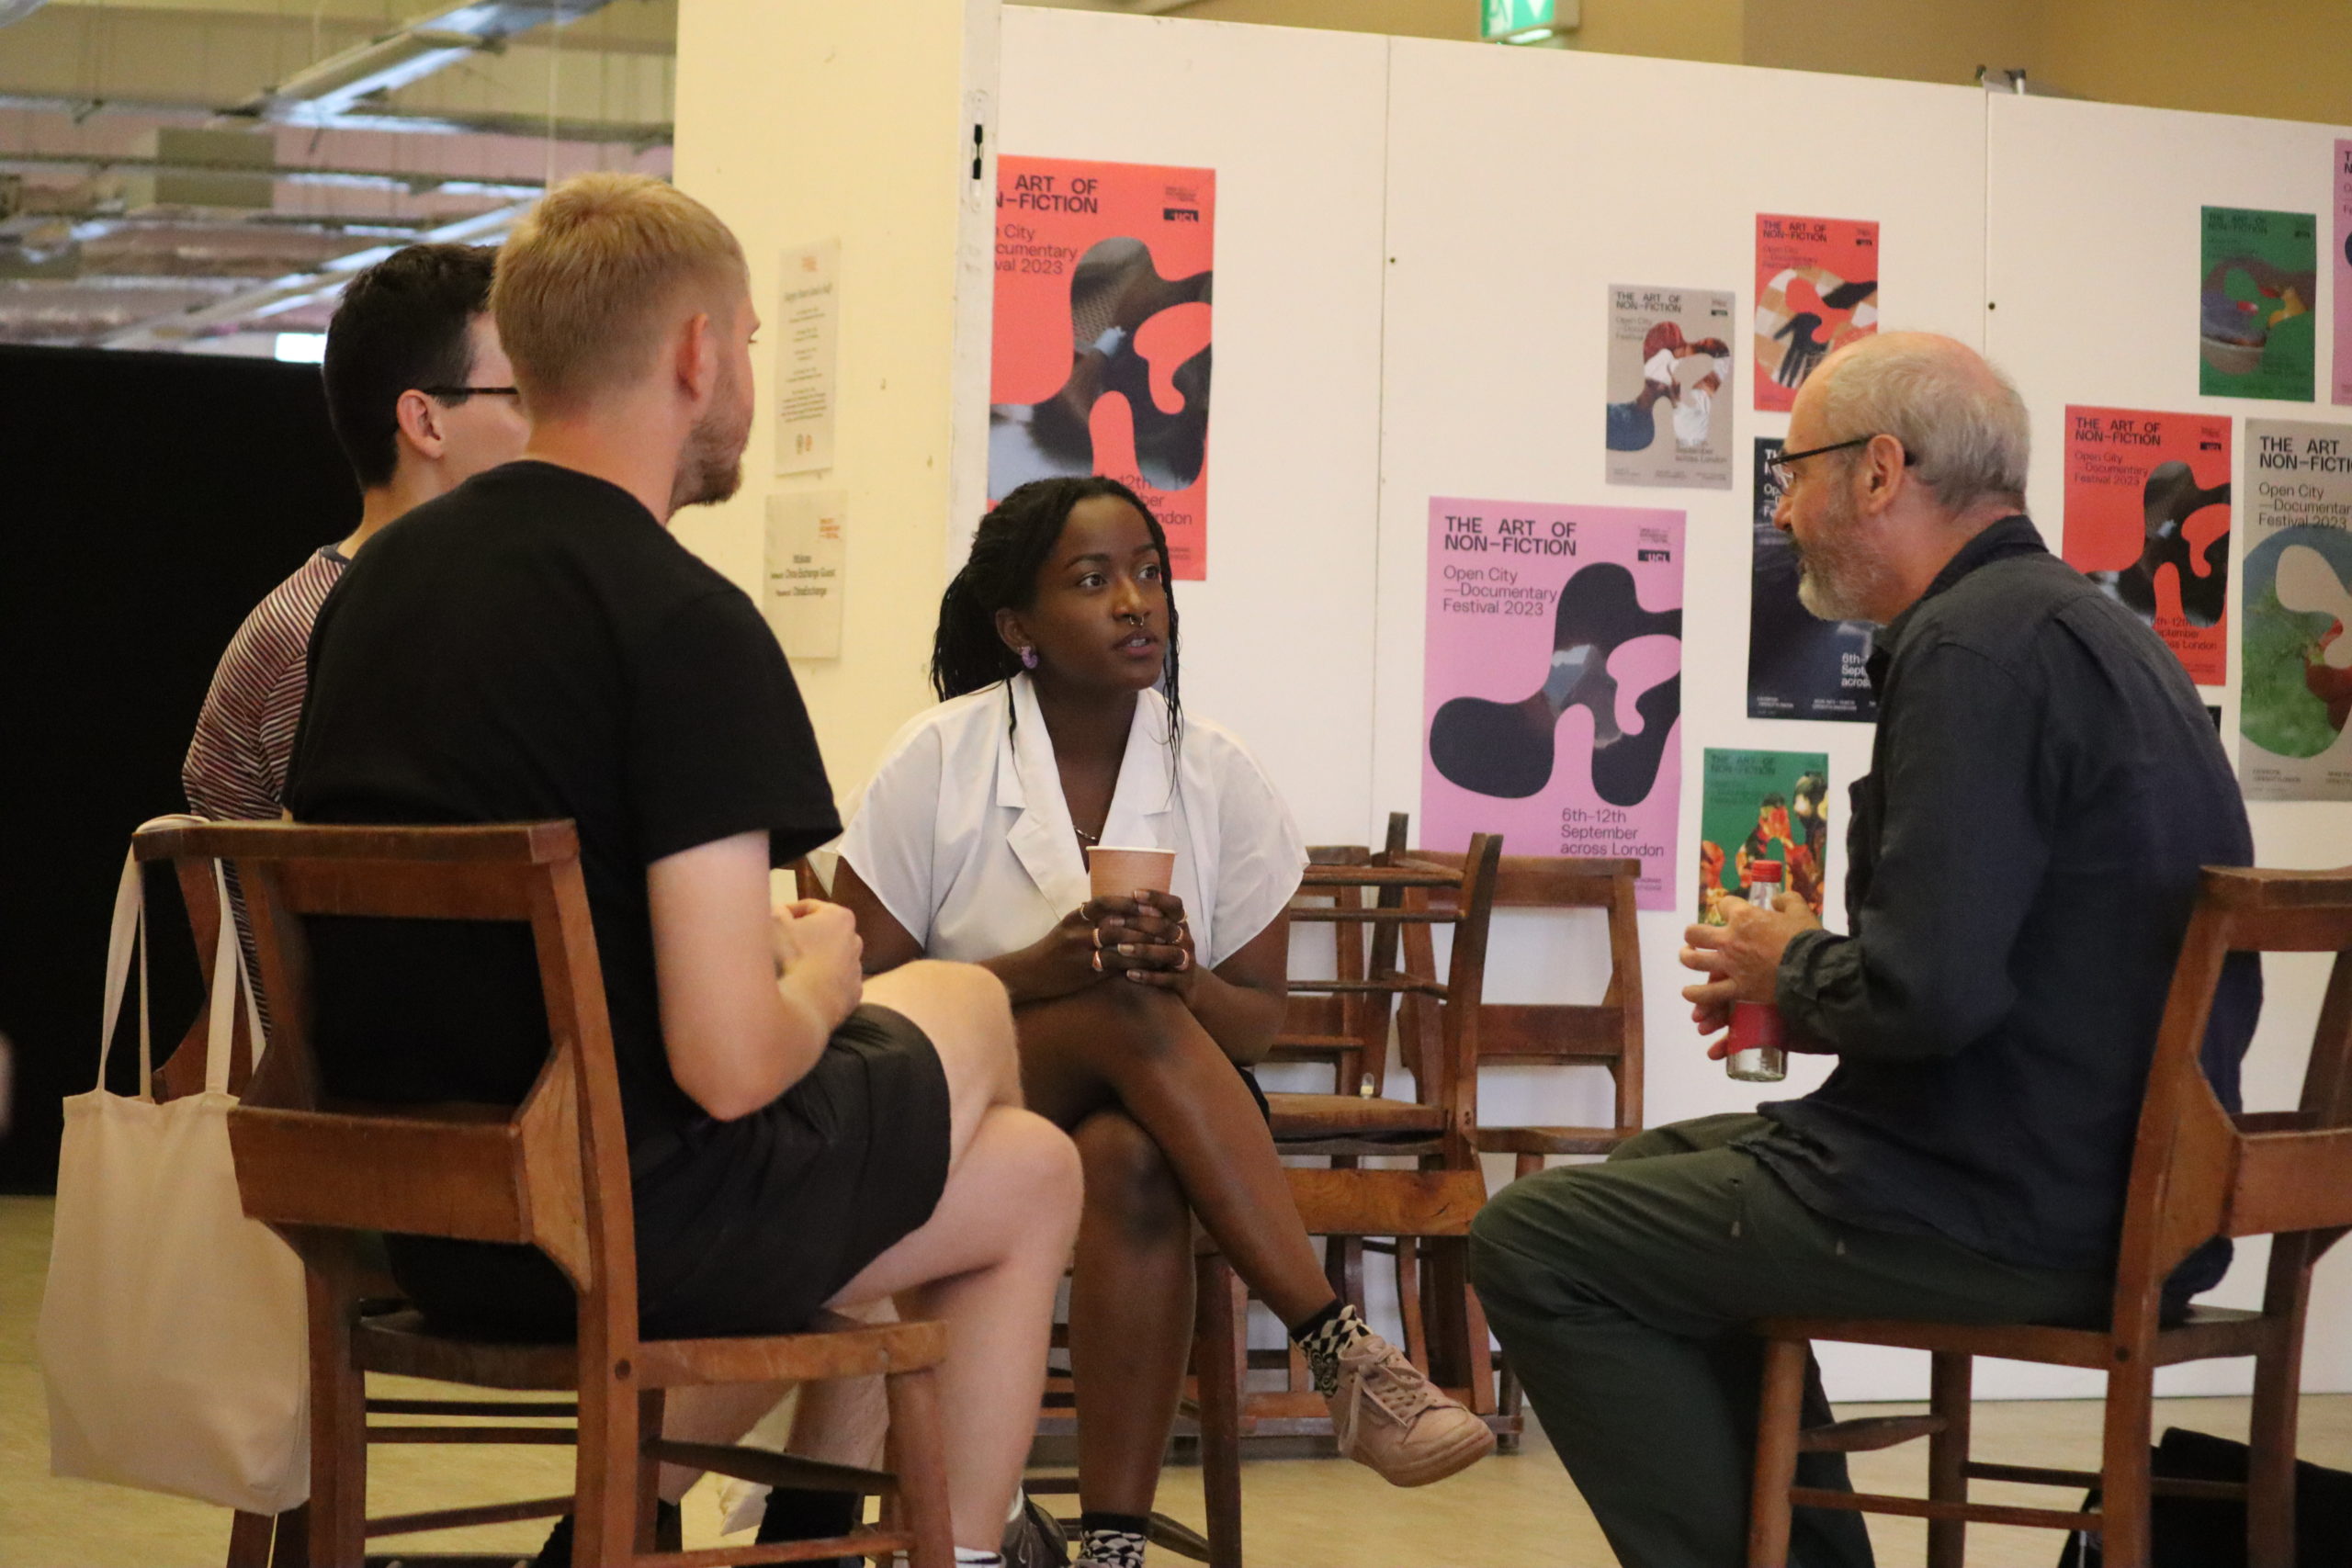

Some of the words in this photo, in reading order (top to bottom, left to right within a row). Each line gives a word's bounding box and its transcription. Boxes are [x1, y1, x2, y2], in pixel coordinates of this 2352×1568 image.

[1014, 175, 1055, 192] ART
[1071, 178, 1098, 195] OF
[1004, 223, 1035, 243] City
[995, 243, 1079, 263] cumentary
[1021, 257, 1063, 275] 2023
[2075, 416, 2099, 429] THE
[2110, 420, 2134, 432] ART
[2143, 423, 2161, 434] OF
[2075, 430, 2161, 446] NON-FICTION
[2259, 435, 2293, 453] THE
[2306, 439, 2340, 456] ART
[2259, 453, 2352, 473] NON-FICTI
[2259, 481, 2294, 498] Open
[2298, 483, 2324, 501] City
[1444, 515, 1483, 534] THE
[1498, 518, 1536, 536] ART
[1550, 521, 1577, 538] OF
[2258, 512, 2308, 529] Festival
[2312, 514, 2347, 530] 2023
[1444, 534, 1577, 557] NON-FICTION
[1443, 564, 1484, 582] Open
[1487, 567, 1518, 585] City
[1443, 599, 1499, 615] Festival
[1504, 601, 1544, 616] 2023
[1562, 807, 1626, 823] 6th-12th
[1561, 824, 1638, 840] September
[1561, 842, 1608, 856] across
[1611, 842, 1664, 857] London
